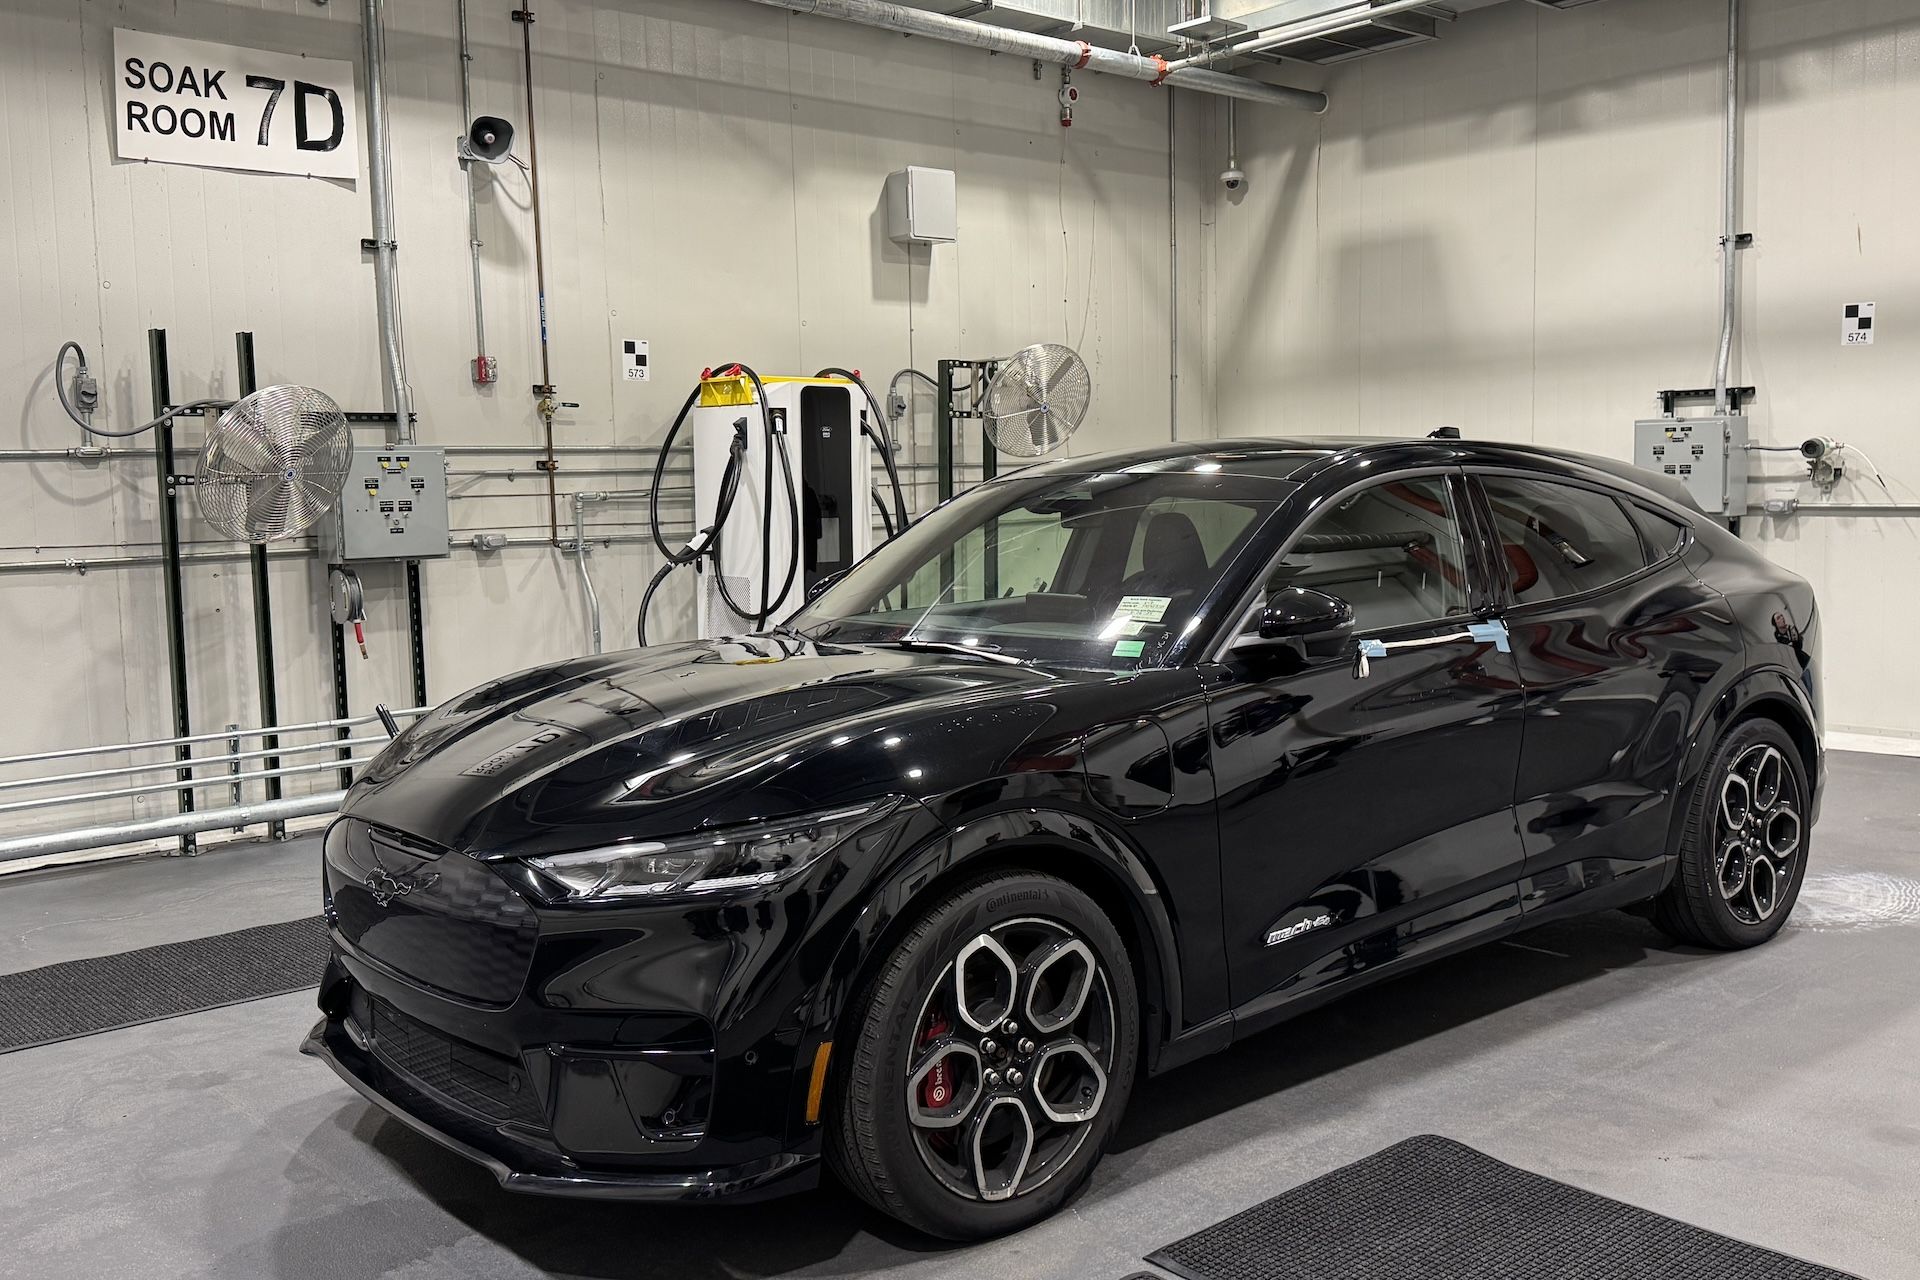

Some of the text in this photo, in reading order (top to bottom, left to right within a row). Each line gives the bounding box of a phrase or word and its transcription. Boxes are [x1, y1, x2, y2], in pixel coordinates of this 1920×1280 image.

[125, 57, 228, 100] SOAK
[126, 100, 236, 142] ROOM
[245, 74, 344, 152] 7D
[1847, 332, 1867, 342] 574
[628, 368, 645, 378] 573
[986, 888, 1041, 913] Continental
